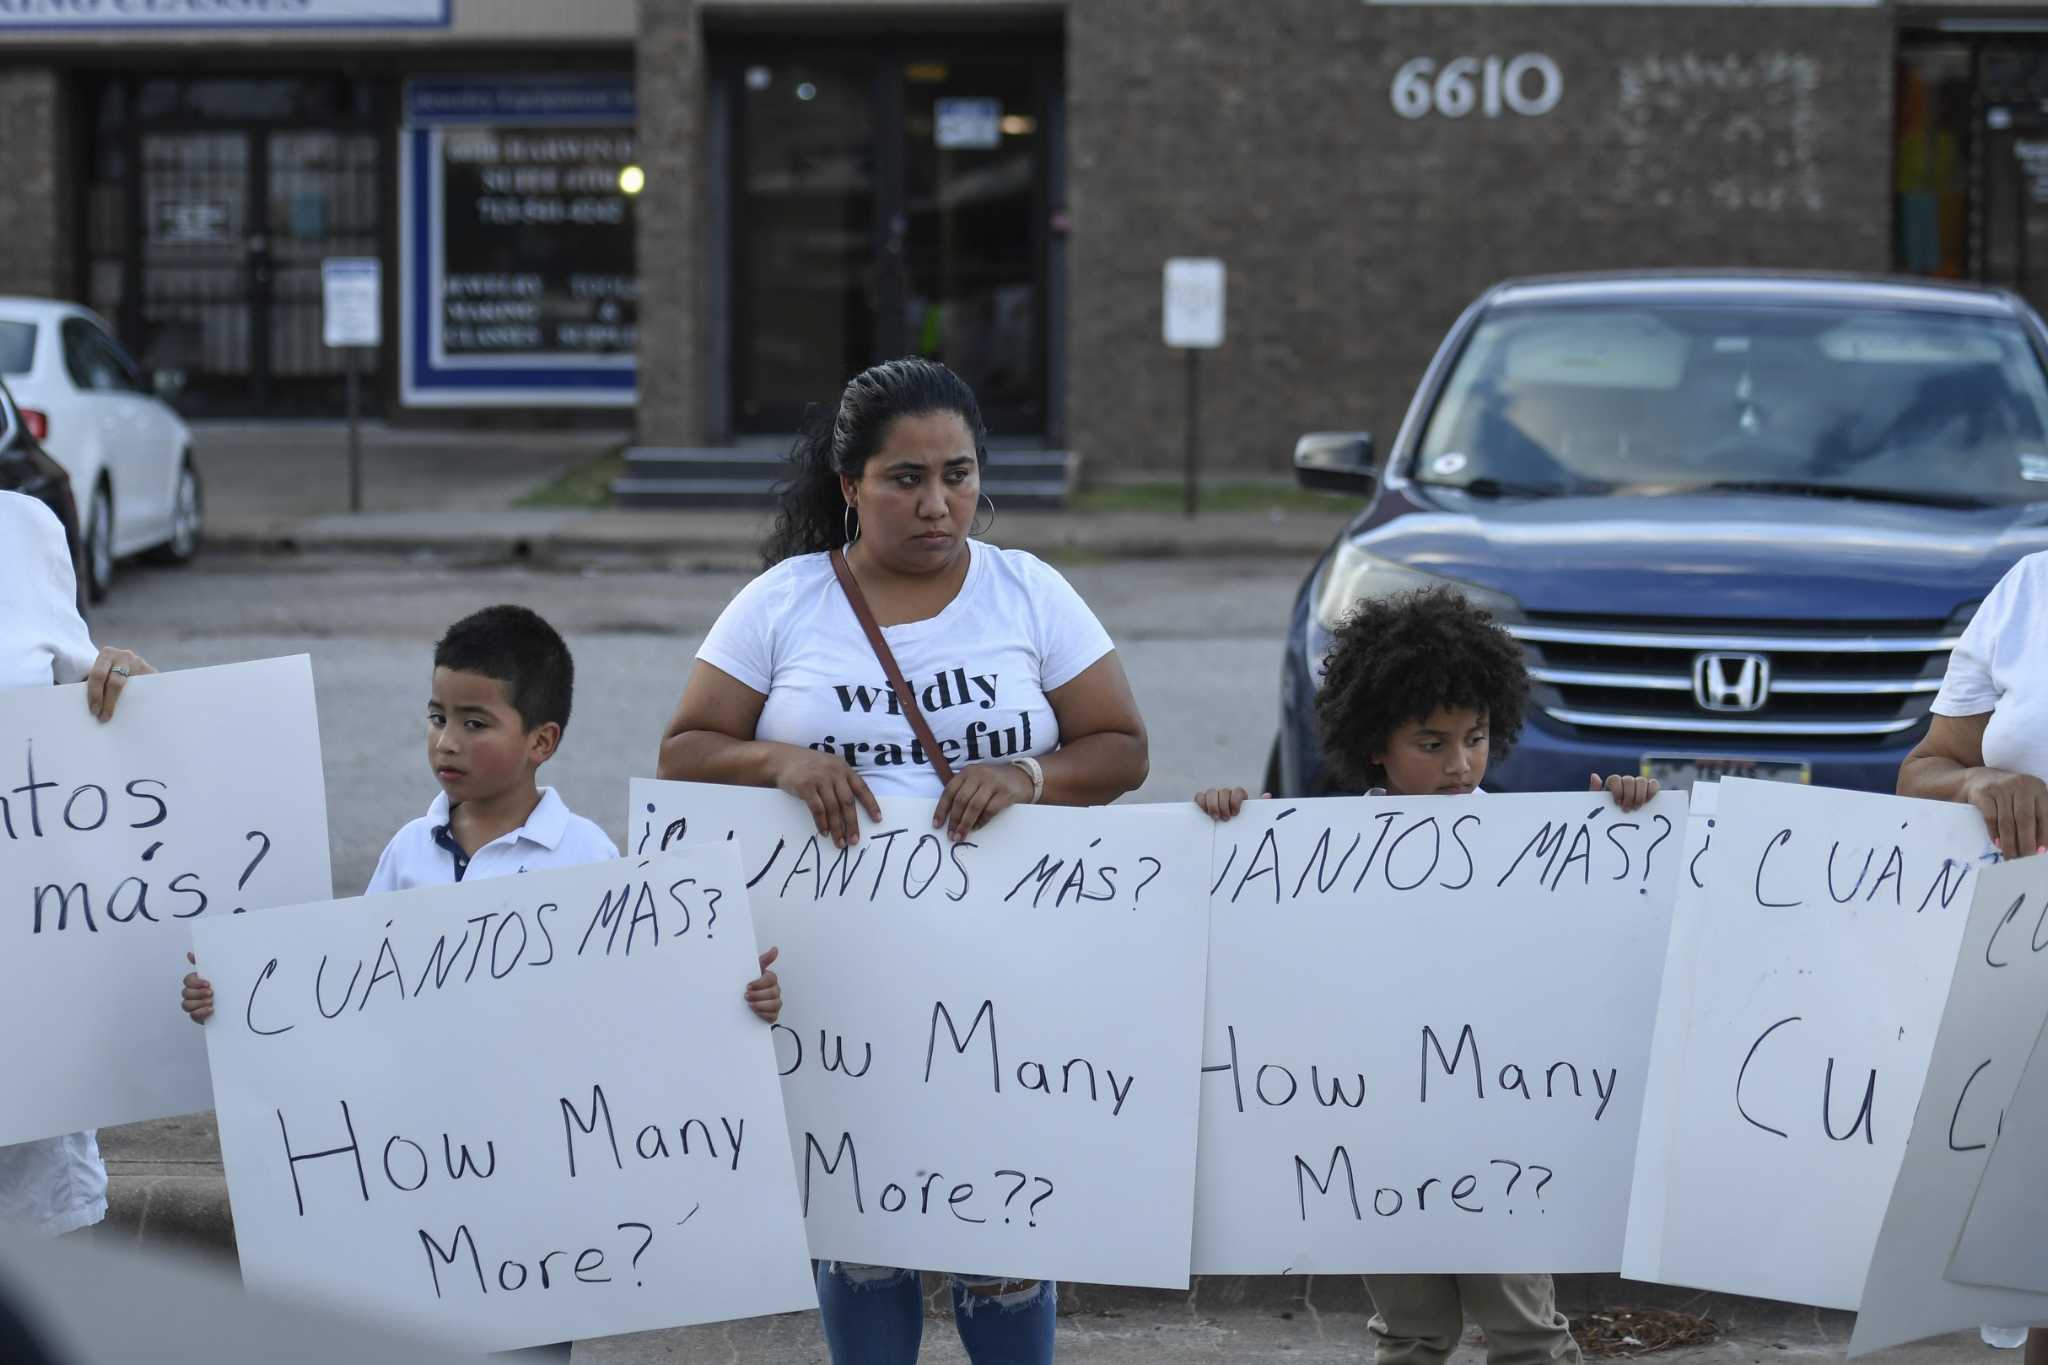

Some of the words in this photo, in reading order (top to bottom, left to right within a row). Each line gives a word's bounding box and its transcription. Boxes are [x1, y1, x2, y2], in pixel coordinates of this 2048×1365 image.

[1391, 53, 1563, 118] 6610
[33, 830, 270, 934] más?
[1003, 837, 1162, 911] MÁS?
[1497, 806, 1672, 895] MÁS?
[246, 903, 558, 1036] CUÁNTOS
[578, 860, 723, 957] MÁS?
[925, 1000, 1135, 1117] Many
[1200, 1025, 1366, 1113] How
[1420, 1023, 1618, 1121] Many
[277, 1100, 496, 1217] How
[560, 1084, 745, 1178] Many
[802, 1131, 1054, 1227] More??
[1294, 1144, 1553, 1221] More??
[418, 1224, 653, 1298] More?
